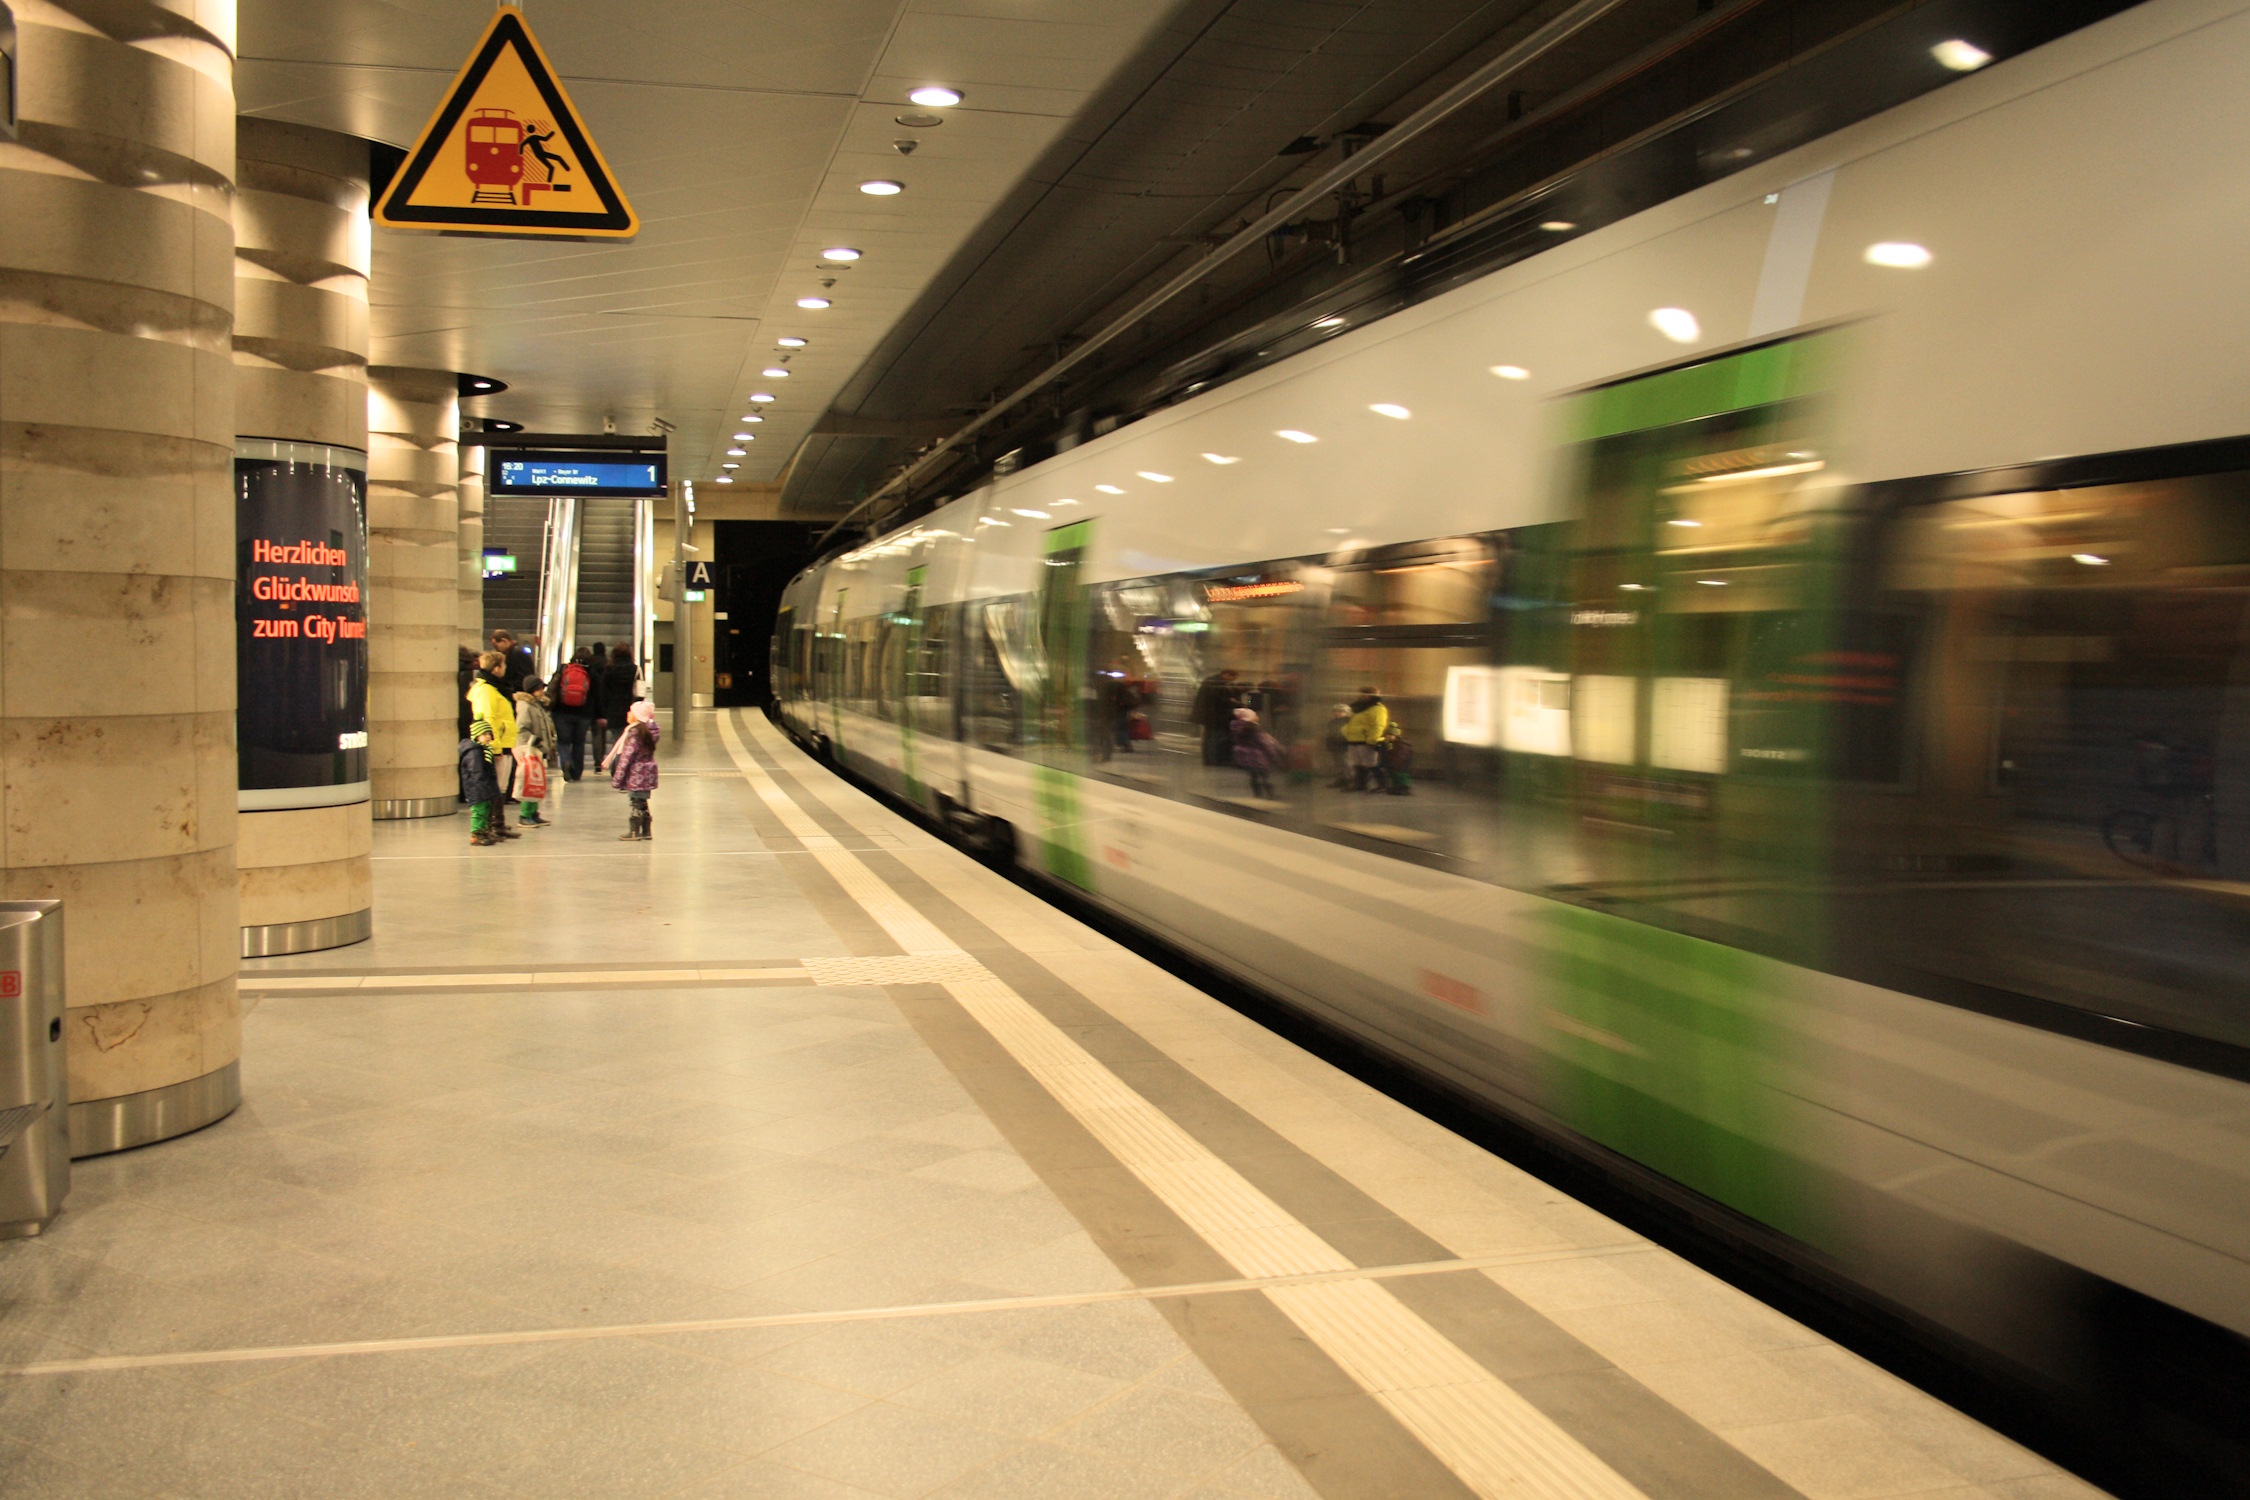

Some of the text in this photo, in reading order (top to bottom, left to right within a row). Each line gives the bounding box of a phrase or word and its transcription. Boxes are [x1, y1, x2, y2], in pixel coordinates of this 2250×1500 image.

[531, 474, 598, 486] Lpz-Connewitz
[647, 465, 655, 482] 1
[254, 540, 346, 566] Herzlichen
[692, 562, 711, 583] A
[253, 619, 299, 637] zum
[303, 615, 336, 644] City
[0, 975, 17, 993] B
